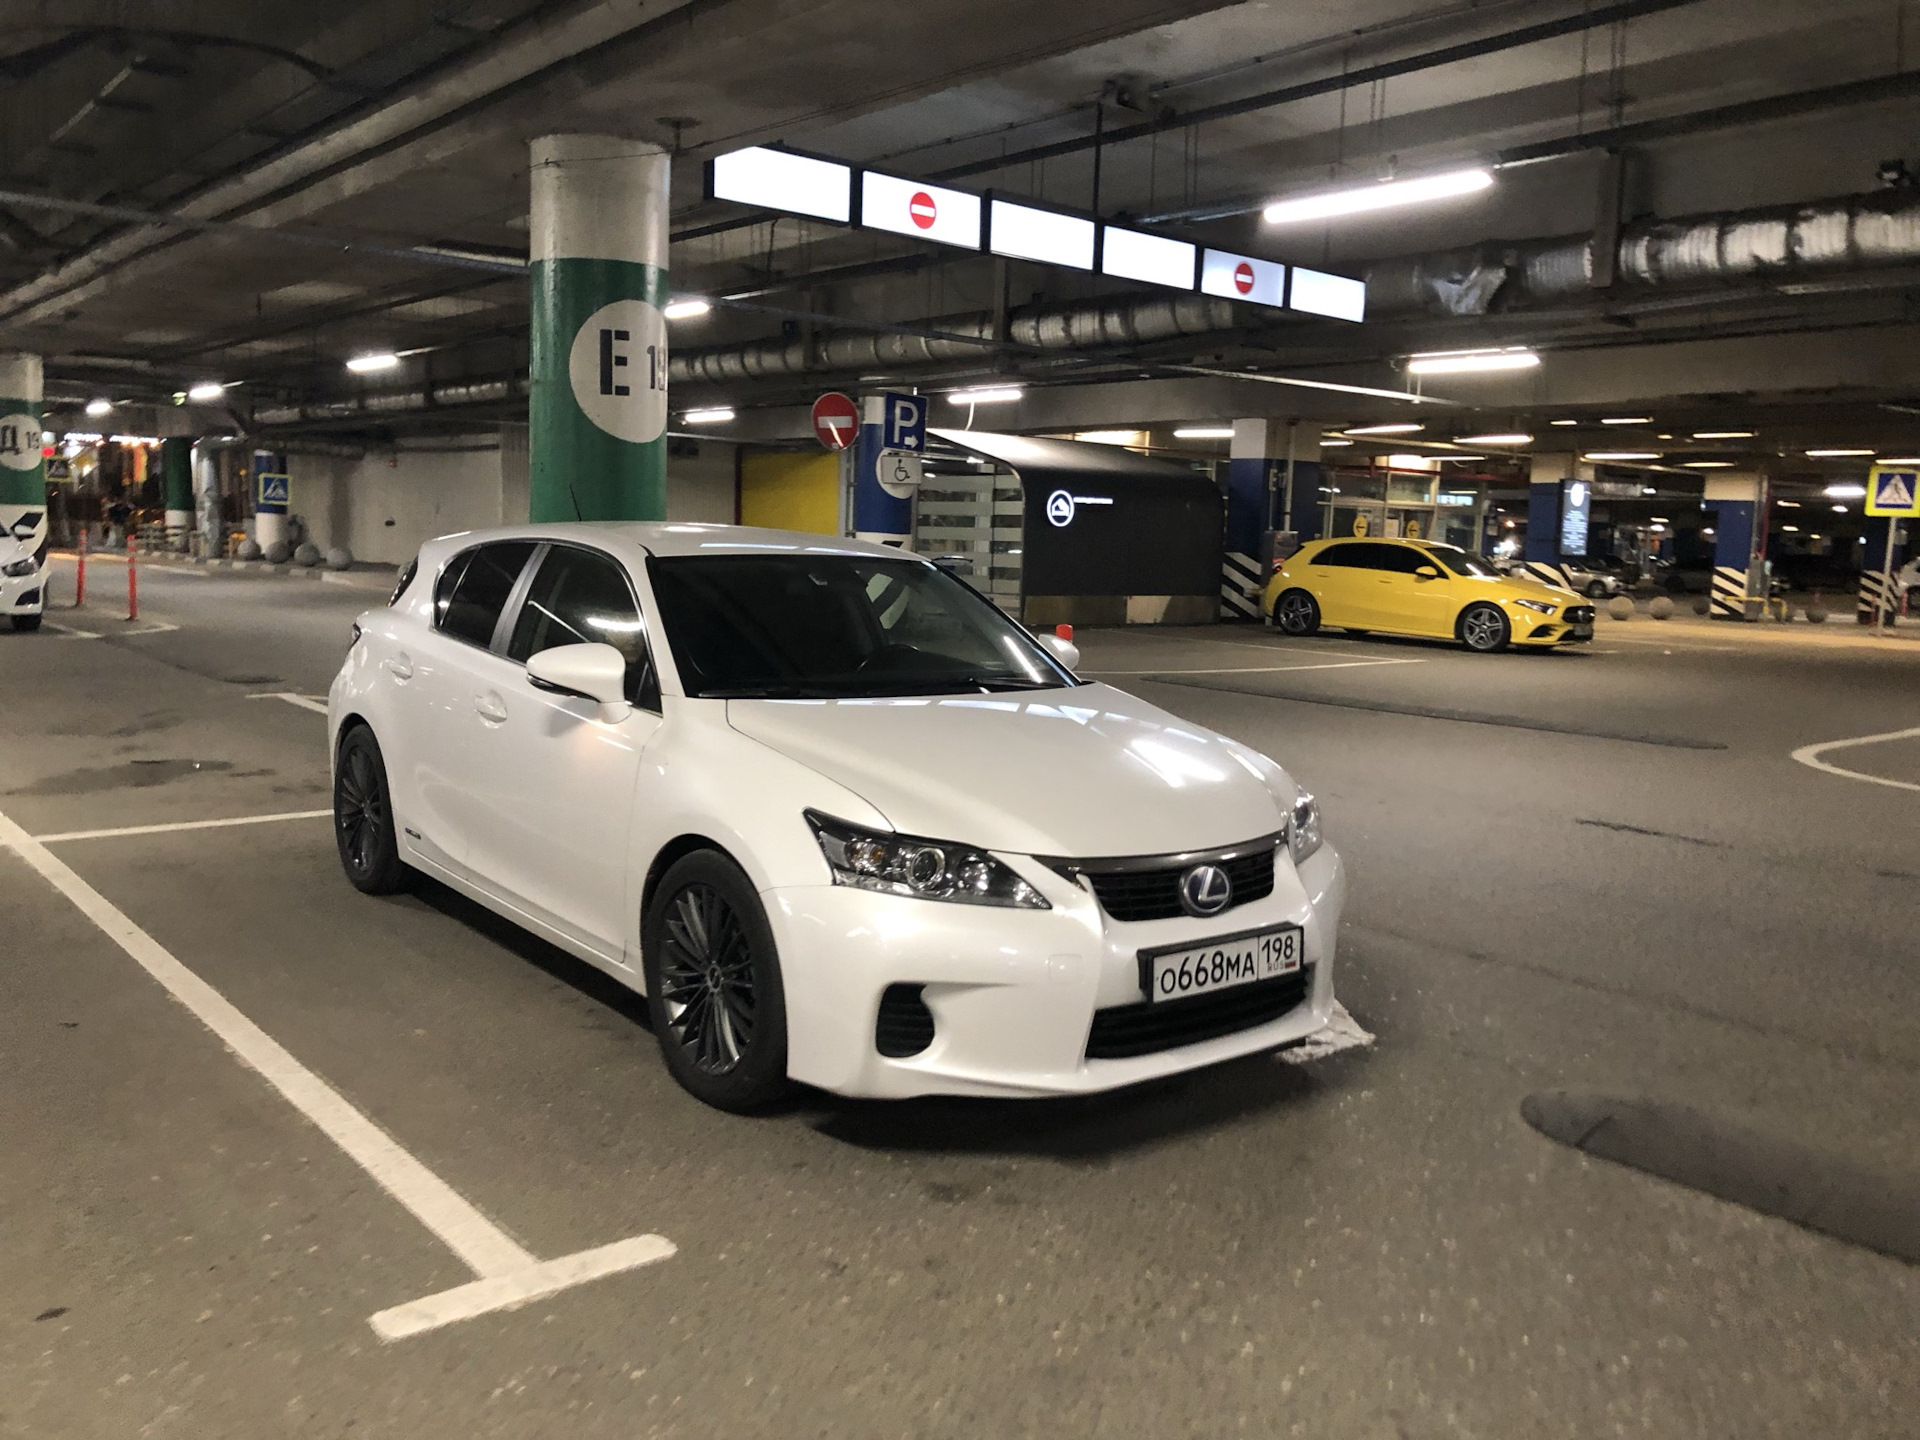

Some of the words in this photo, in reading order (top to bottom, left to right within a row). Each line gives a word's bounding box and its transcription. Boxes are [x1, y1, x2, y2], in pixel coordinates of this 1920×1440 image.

[600, 329, 630, 396] Е
[894, 400, 918, 443] P
[1161, 951, 1255, 994] О668МА
[1262, 935, 1294, 963] 198
[1267, 961, 1284, 972] RUS
